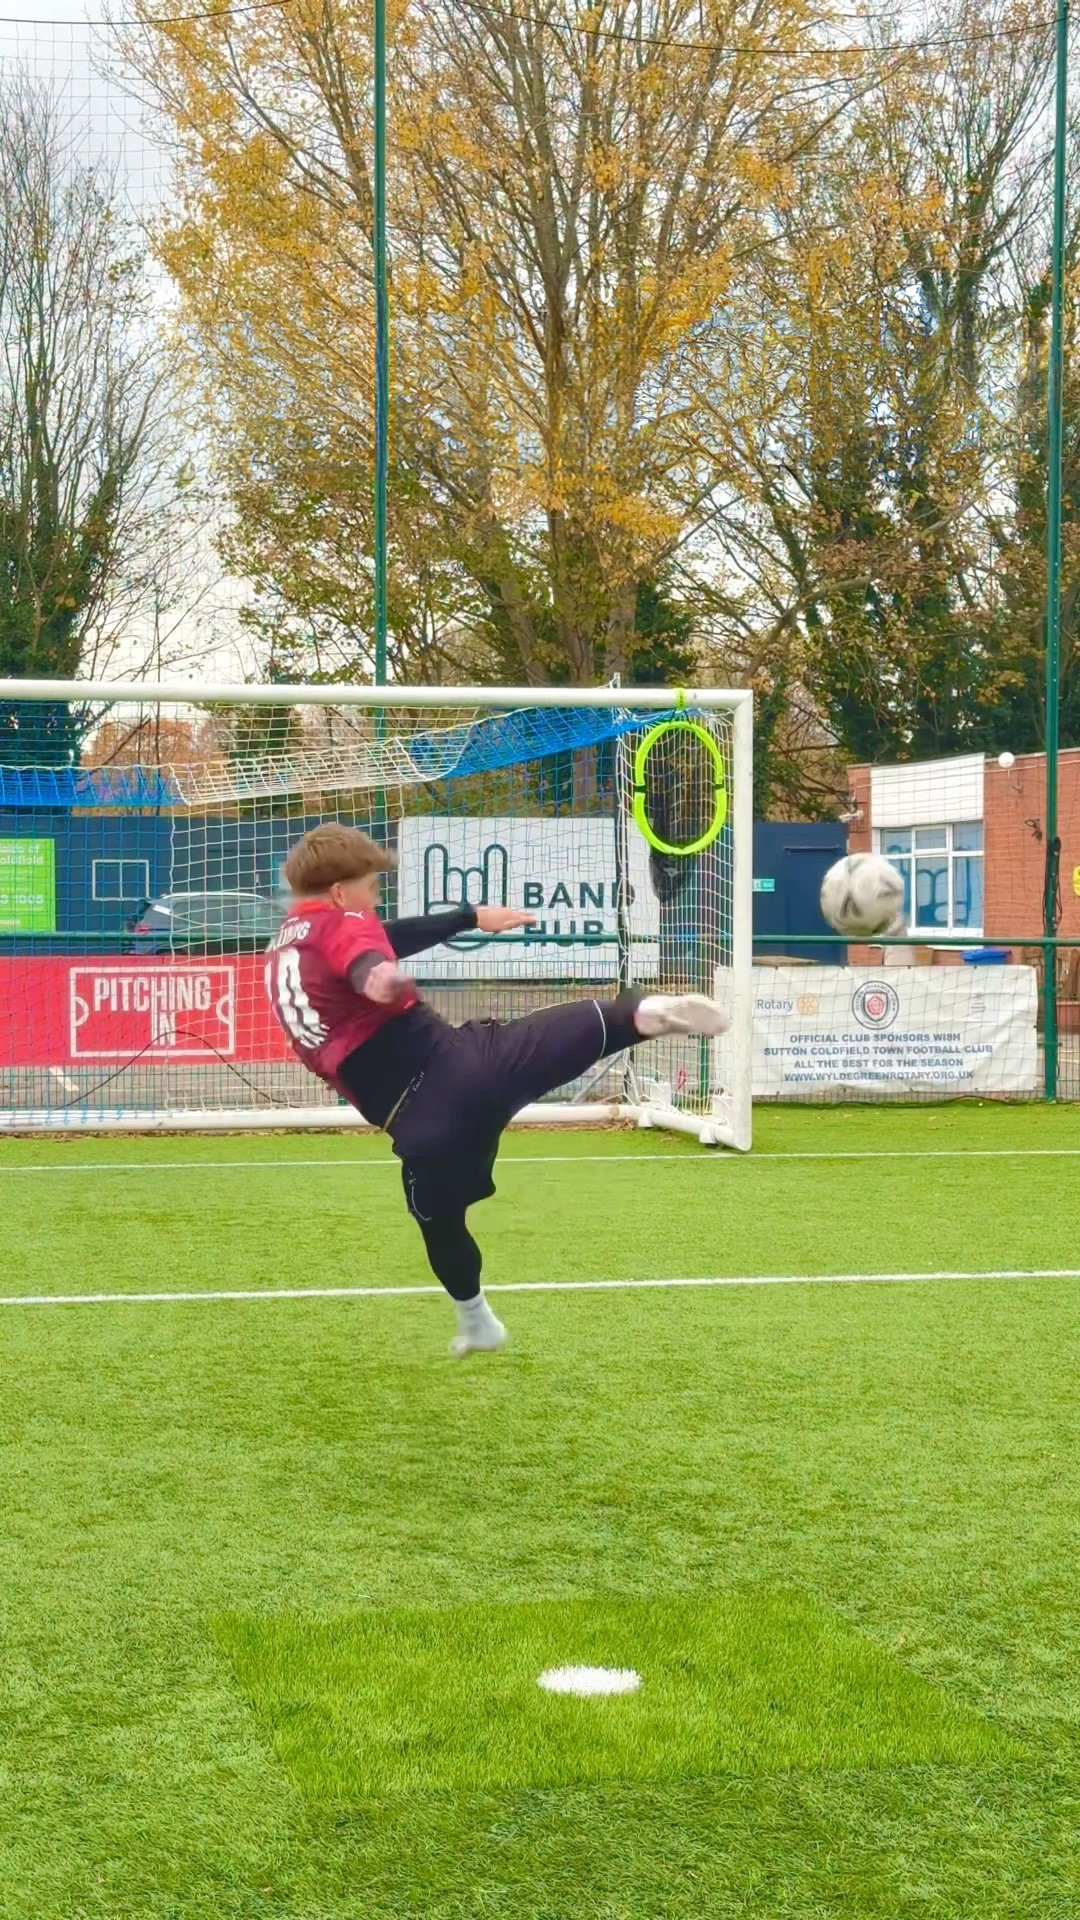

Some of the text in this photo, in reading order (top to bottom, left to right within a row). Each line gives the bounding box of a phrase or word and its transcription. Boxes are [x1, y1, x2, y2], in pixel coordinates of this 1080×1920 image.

[524, 844, 594, 873] THE
[523, 881, 636, 909] BAND
[523, 920, 605, 948] HUB
[94, 976, 211, 1012] PITCHING
[756, 998, 794, 1012] Rotary
[152, 1009, 176, 1046] IN
[789, 1032, 961, 1044] OFFICIAL CLUB SPONSORS WISH
[763, 1044, 993, 1056] SUTTON COLDFIELD TOWN FOOTBALL CLUB
[794, 1057, 964, 1069] ALL THE BEST FOR THE SEASON
[784, 1069, 975, 1082] WWW.WYLDEGREENROTARY.ORG.UK
